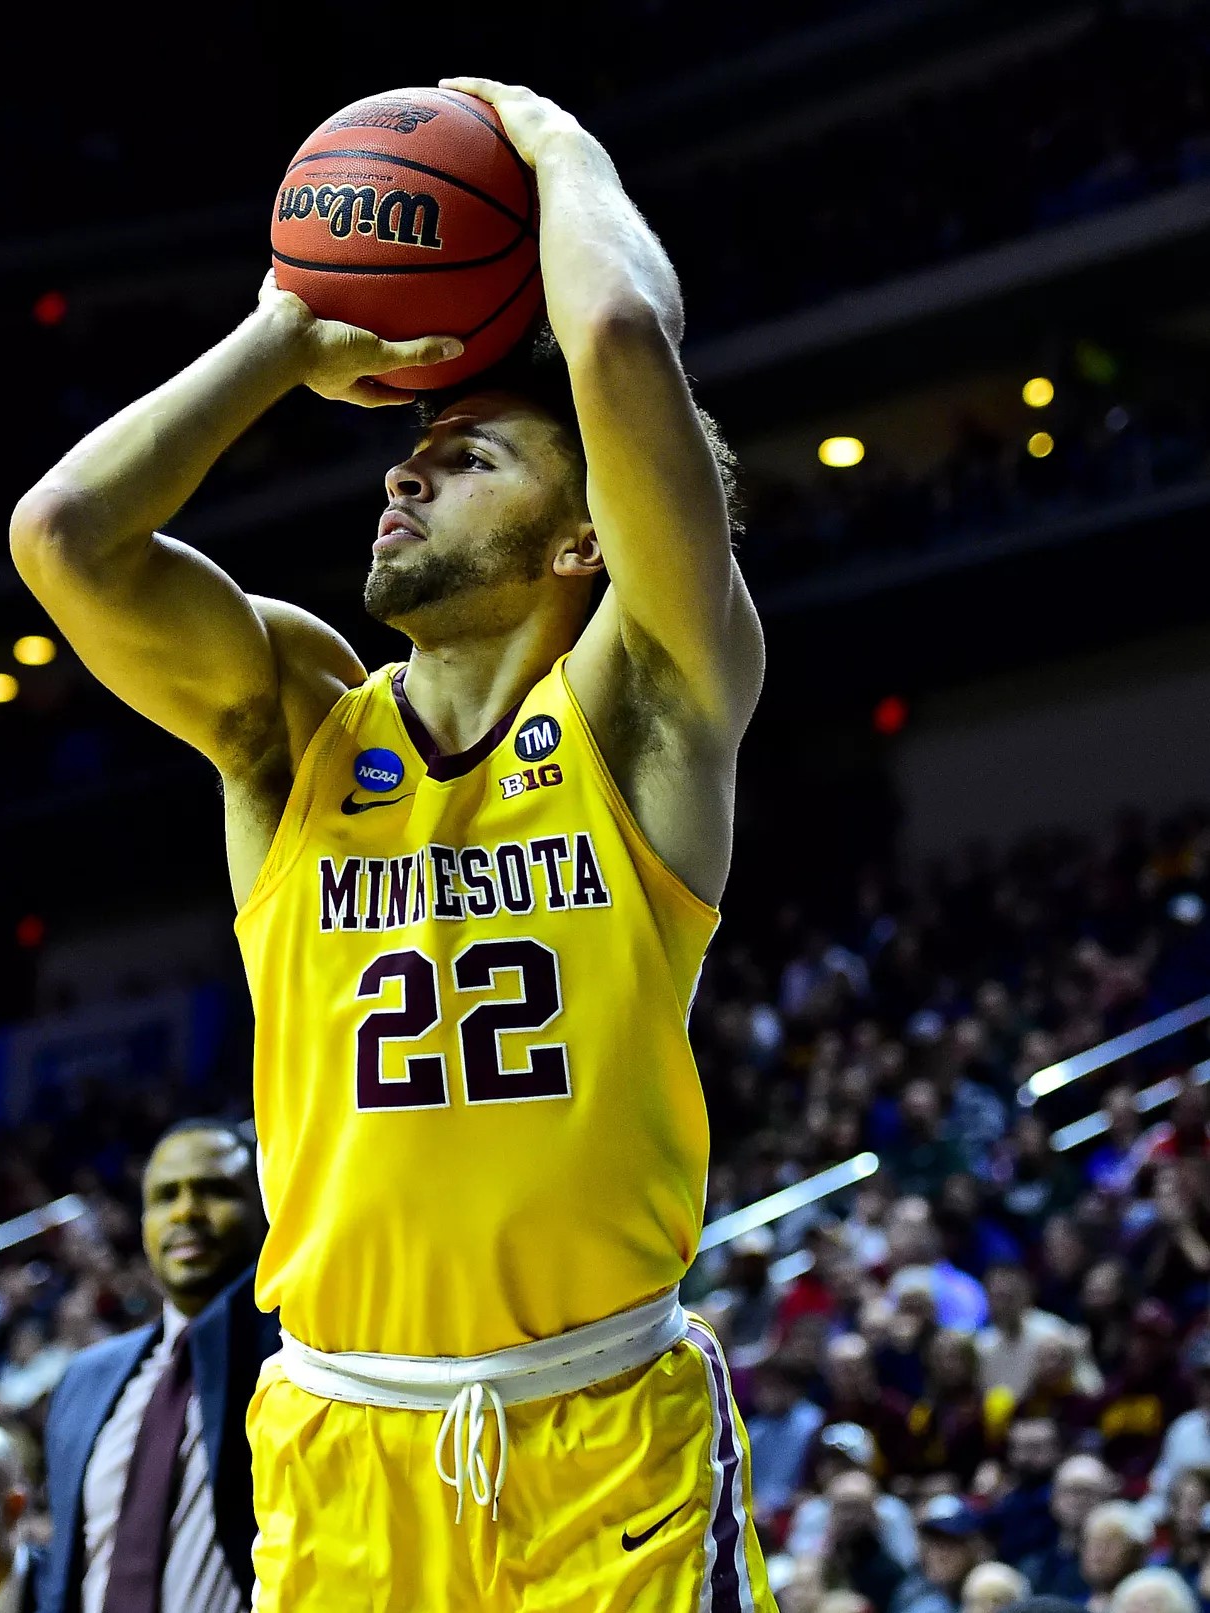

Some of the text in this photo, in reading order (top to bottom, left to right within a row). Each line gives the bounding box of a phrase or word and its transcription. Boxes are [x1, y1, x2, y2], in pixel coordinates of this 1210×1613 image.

[278, 183, 443, 250] Wilson
[518, 721, 555, 755] TM
[358, 765, 399, 784] NCAA
[354, 936, 572, 1113] 22
